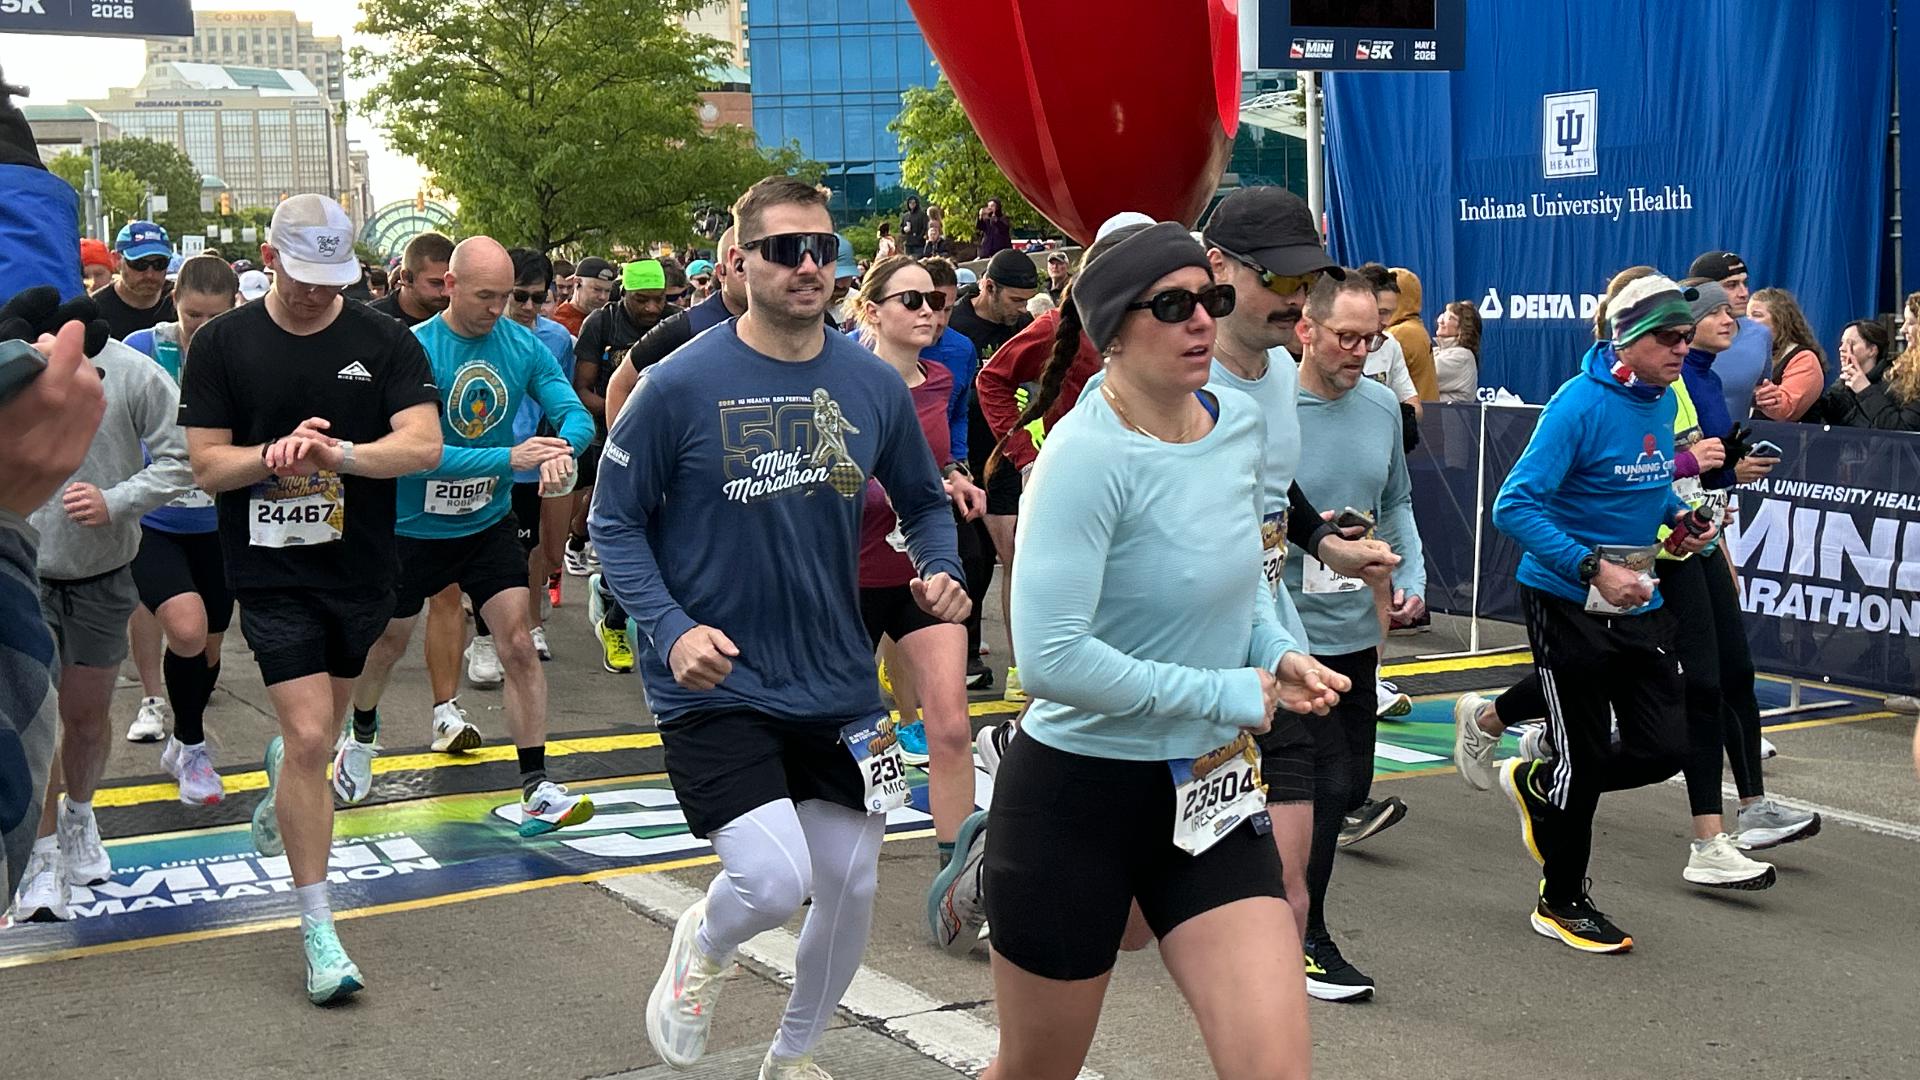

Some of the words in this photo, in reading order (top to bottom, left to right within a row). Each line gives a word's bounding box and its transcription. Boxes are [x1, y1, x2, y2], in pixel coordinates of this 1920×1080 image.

[91, 4, 134, 19] 2026
[1306, 43, 1334, 53] MINI
[1370, 45, 1393, 59] 5K
[1414, 41, 1429, 49] MAY
[1431, 41, 1436, 49] 2
[1550, 157, 1591, 170] HEALTH
[1460, 198, 1526, 221] Indiana
[1531, 192, 1623, 221] University
[1628, 185, 1692, 213] Health
[1510, 294, 1575, 319] DELTA
[1614, 461, 1661, 475] RUNNING
[435, 480, 491, 499] 20601
[723, 466, 830, 504] Marathon
[1774, 479, 1872, 505] UNIVERSITY
[258, 503, 335, 525] 24467
[1183, 767, 1255, 821] 23504
